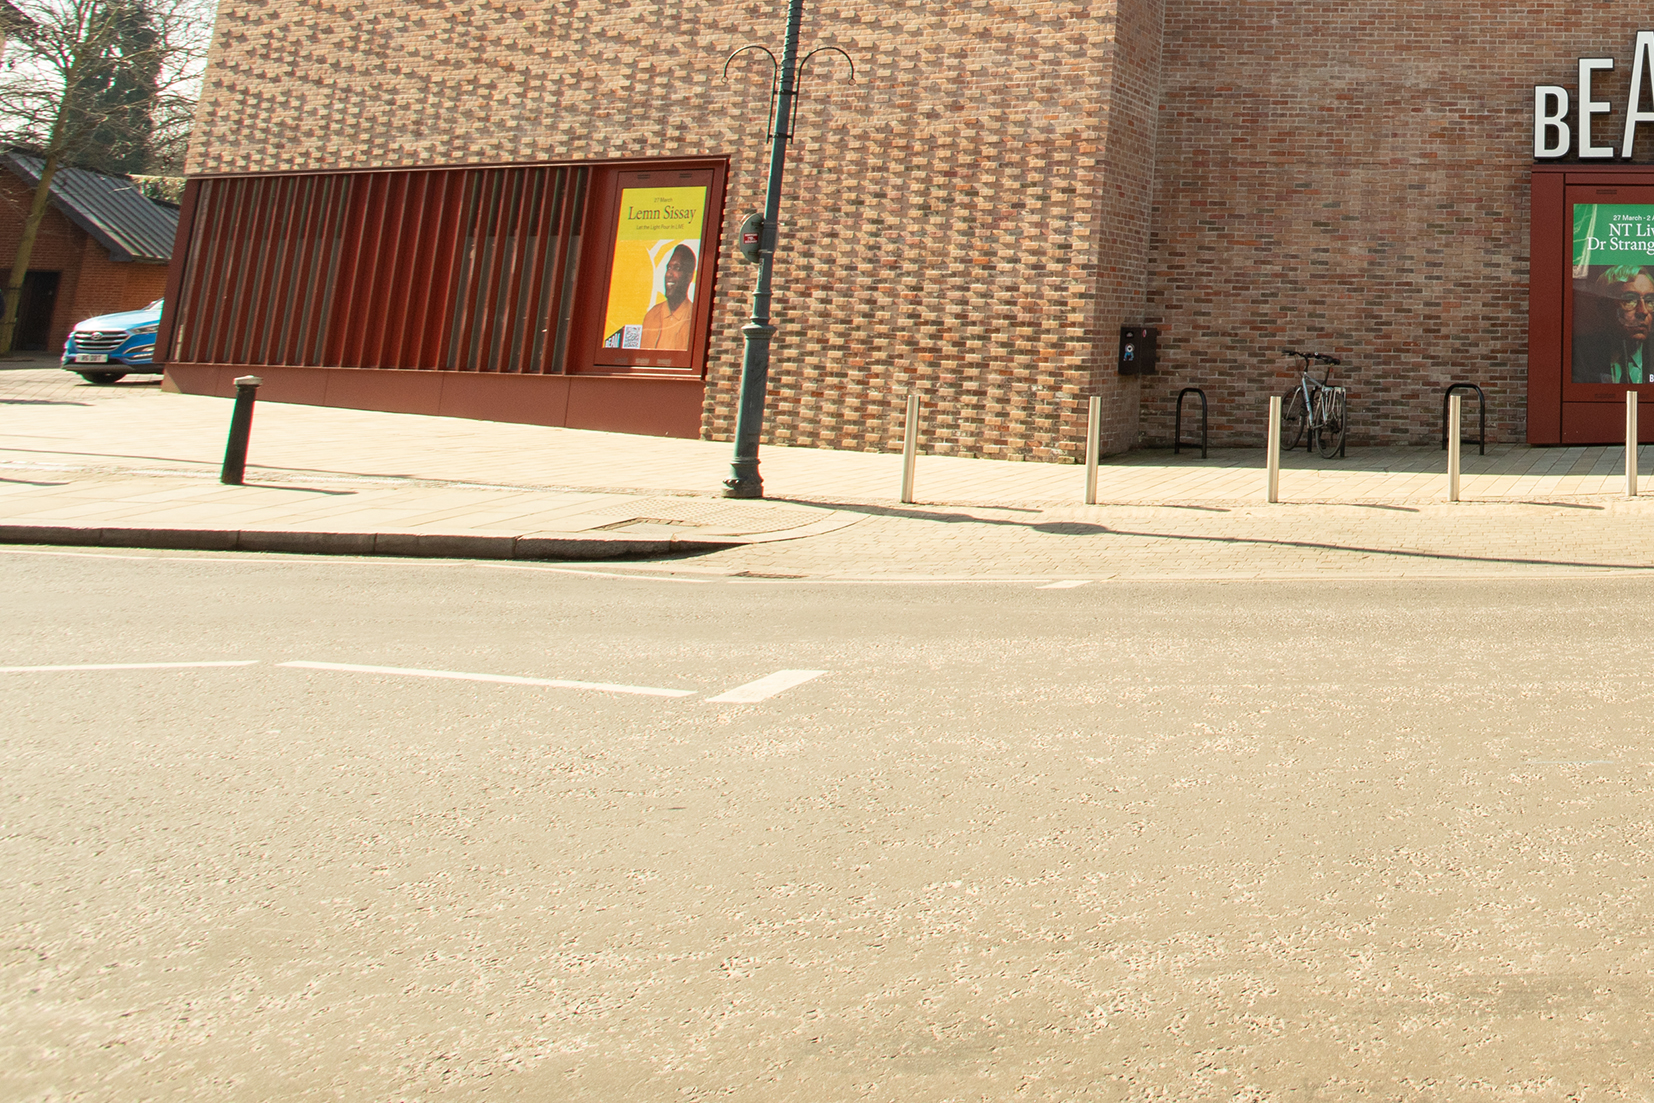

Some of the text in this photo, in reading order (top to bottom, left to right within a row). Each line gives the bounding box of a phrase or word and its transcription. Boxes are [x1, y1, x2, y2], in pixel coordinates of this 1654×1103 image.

[627, 204, 697, 224] Lemn Sissay
[1608, 223, 1633, 237] NT
[1587, 236, 1607, 251] Dr
